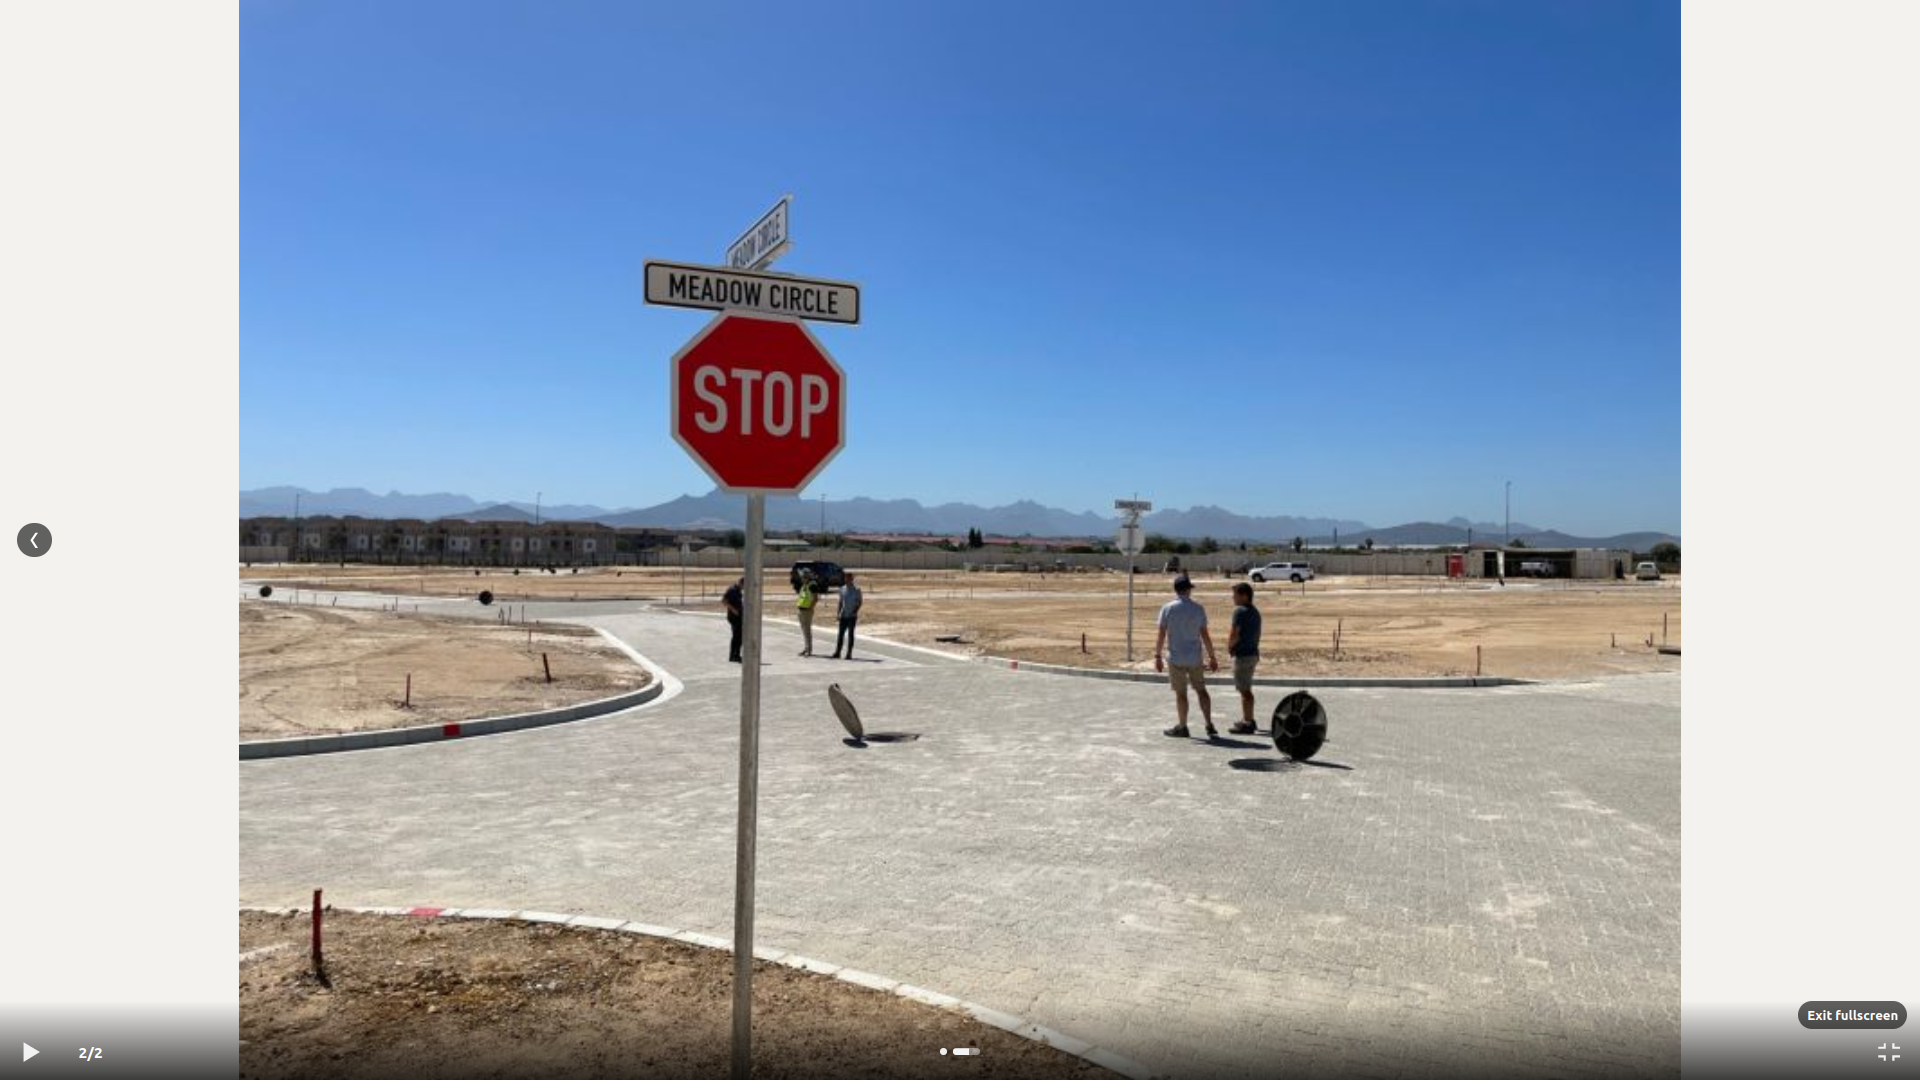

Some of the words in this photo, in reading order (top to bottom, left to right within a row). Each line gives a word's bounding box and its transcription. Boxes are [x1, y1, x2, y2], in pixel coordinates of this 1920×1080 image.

[758, 213, 780, 254] CIRCLE
[669, 273, 763, 307] MEADOW
[770, 284, 839, 315] CIRCLE
[693, 365, 830, 439] STOP
